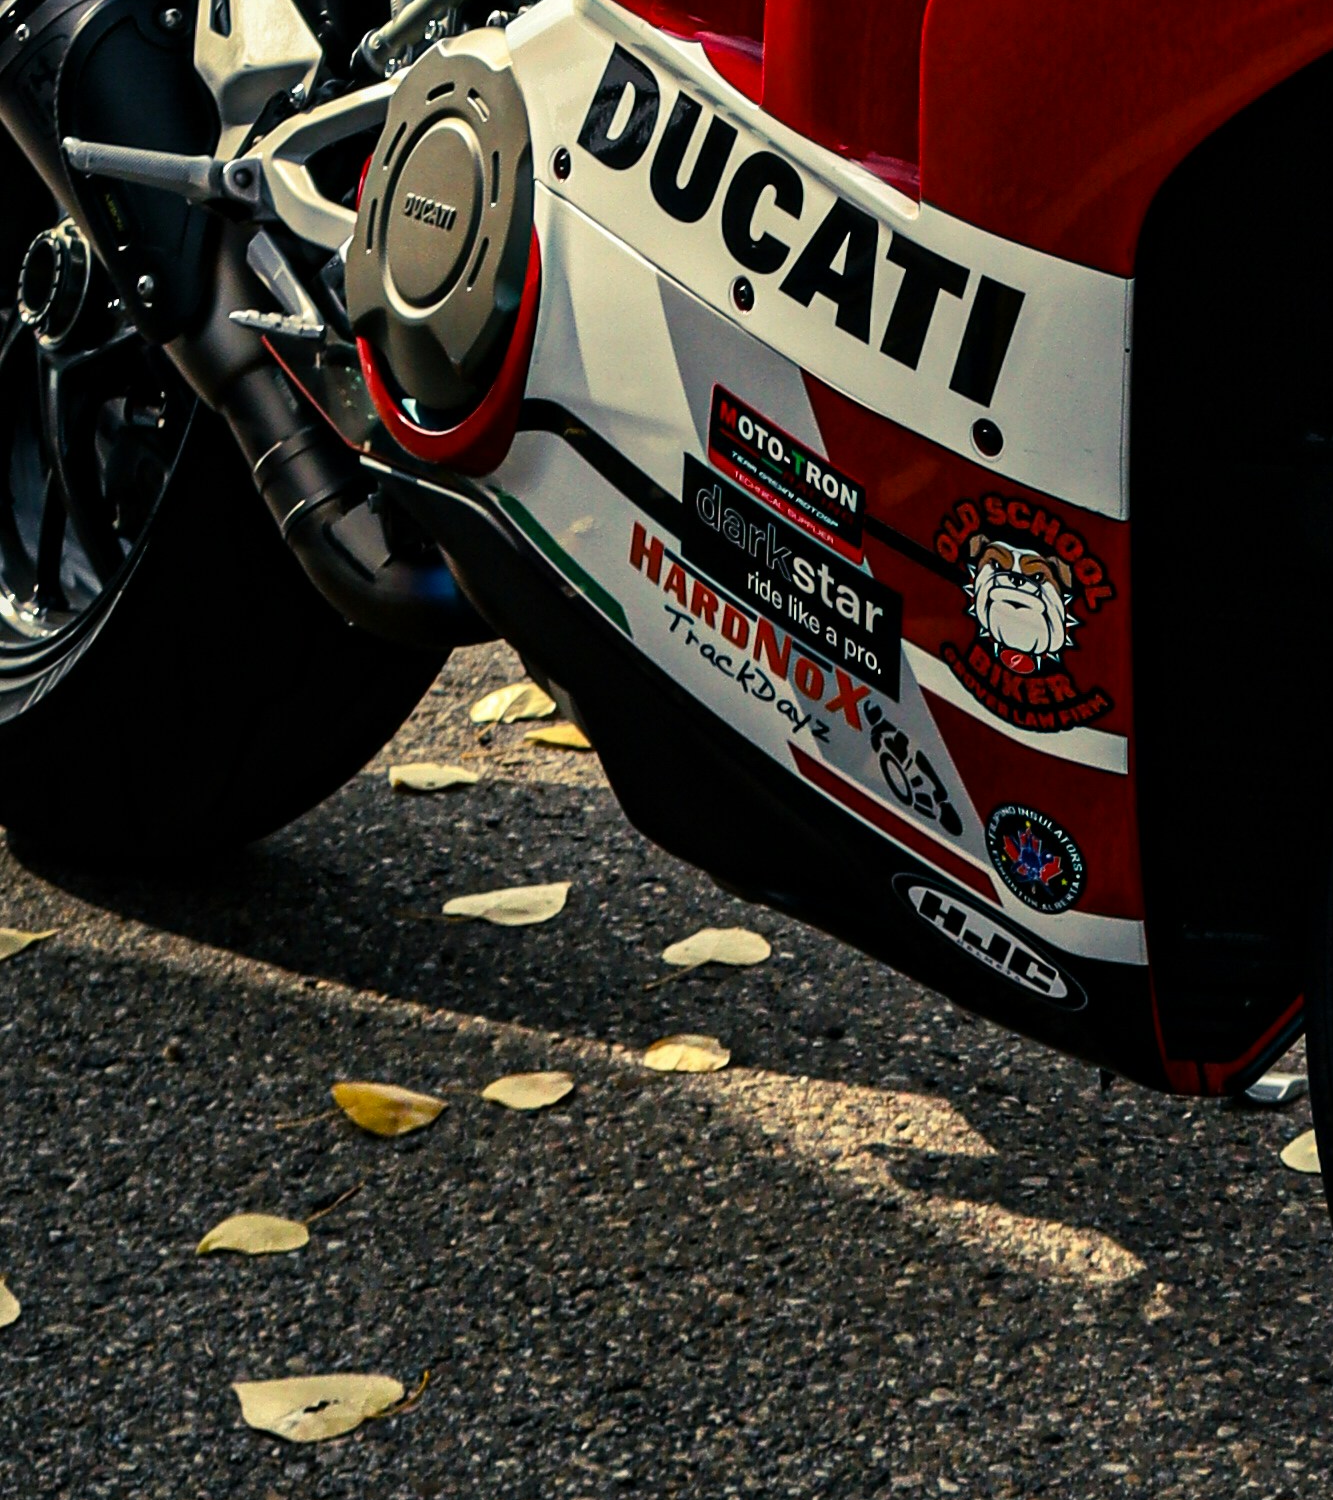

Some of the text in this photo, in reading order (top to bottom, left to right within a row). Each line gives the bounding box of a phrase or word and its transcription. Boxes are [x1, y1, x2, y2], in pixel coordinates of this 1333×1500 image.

[405, 192, 457, 231] DUCATI
[576, 43, 1027, 408] DUCATI
[720, 400, 859, 514] MOTO-TRON
[696, 484, 884, 634] darkstar
[936, 497, 1113, 610] OLD SCHOOL
[747, 570, 882, 676] ride like a pro.
[968, 643, 1077, 705] BIKER
[1013, 708, 1056, 728] LAW
[1059, 693, 1109, 726] FIRM
[1017, 805, 1083, 872] INSULATORS
[918, 890, 1058, 994] HJC
